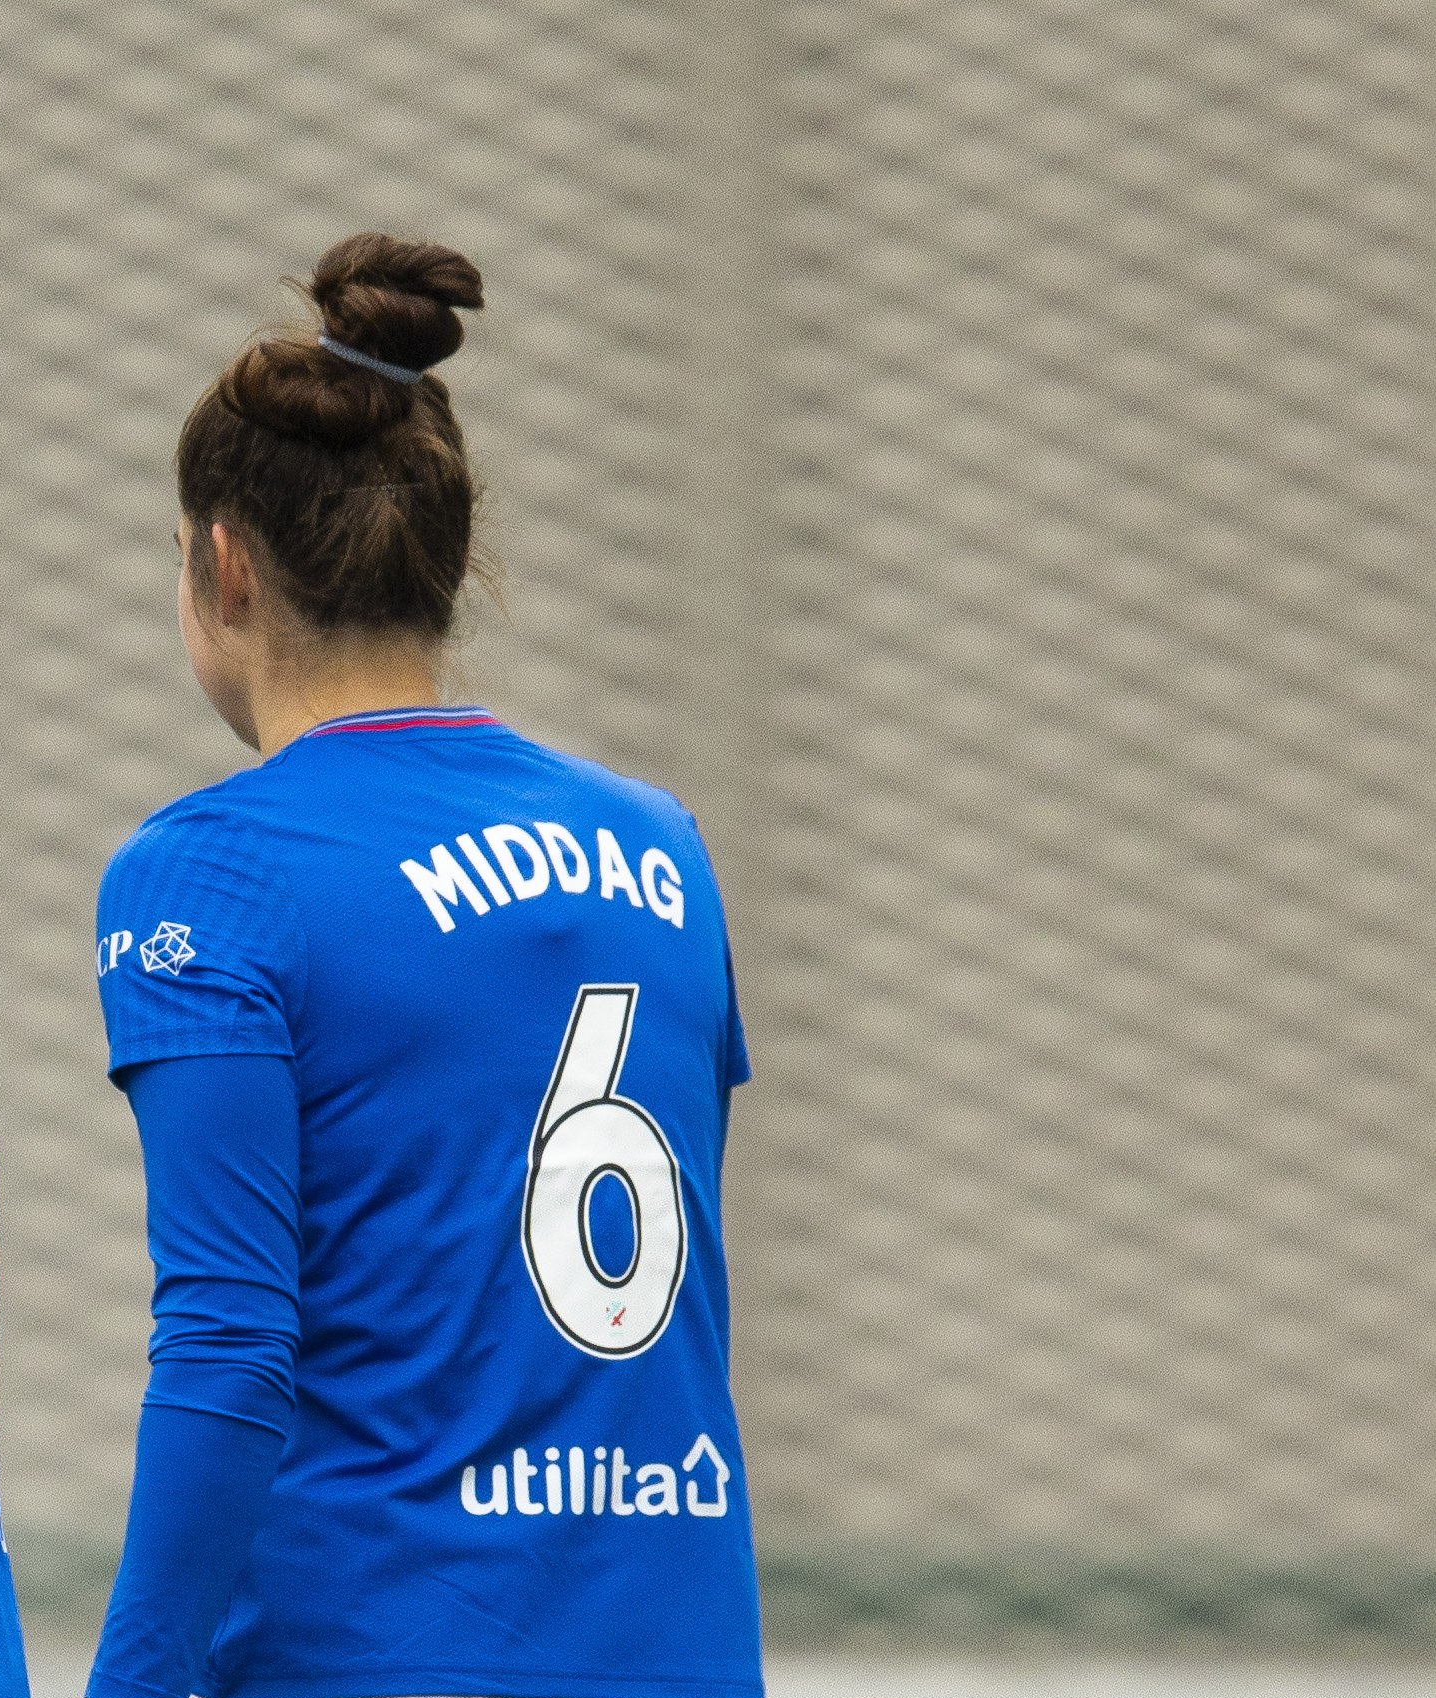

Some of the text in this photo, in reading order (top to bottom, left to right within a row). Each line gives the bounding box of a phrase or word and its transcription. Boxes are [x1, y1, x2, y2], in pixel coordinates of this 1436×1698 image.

[400, 822, 685, 933] MIDDAG
[97, 930, 133, 977] CP
[520, 983, 690, 1360] 6
[460, 1447, 678, 1516] utilita
